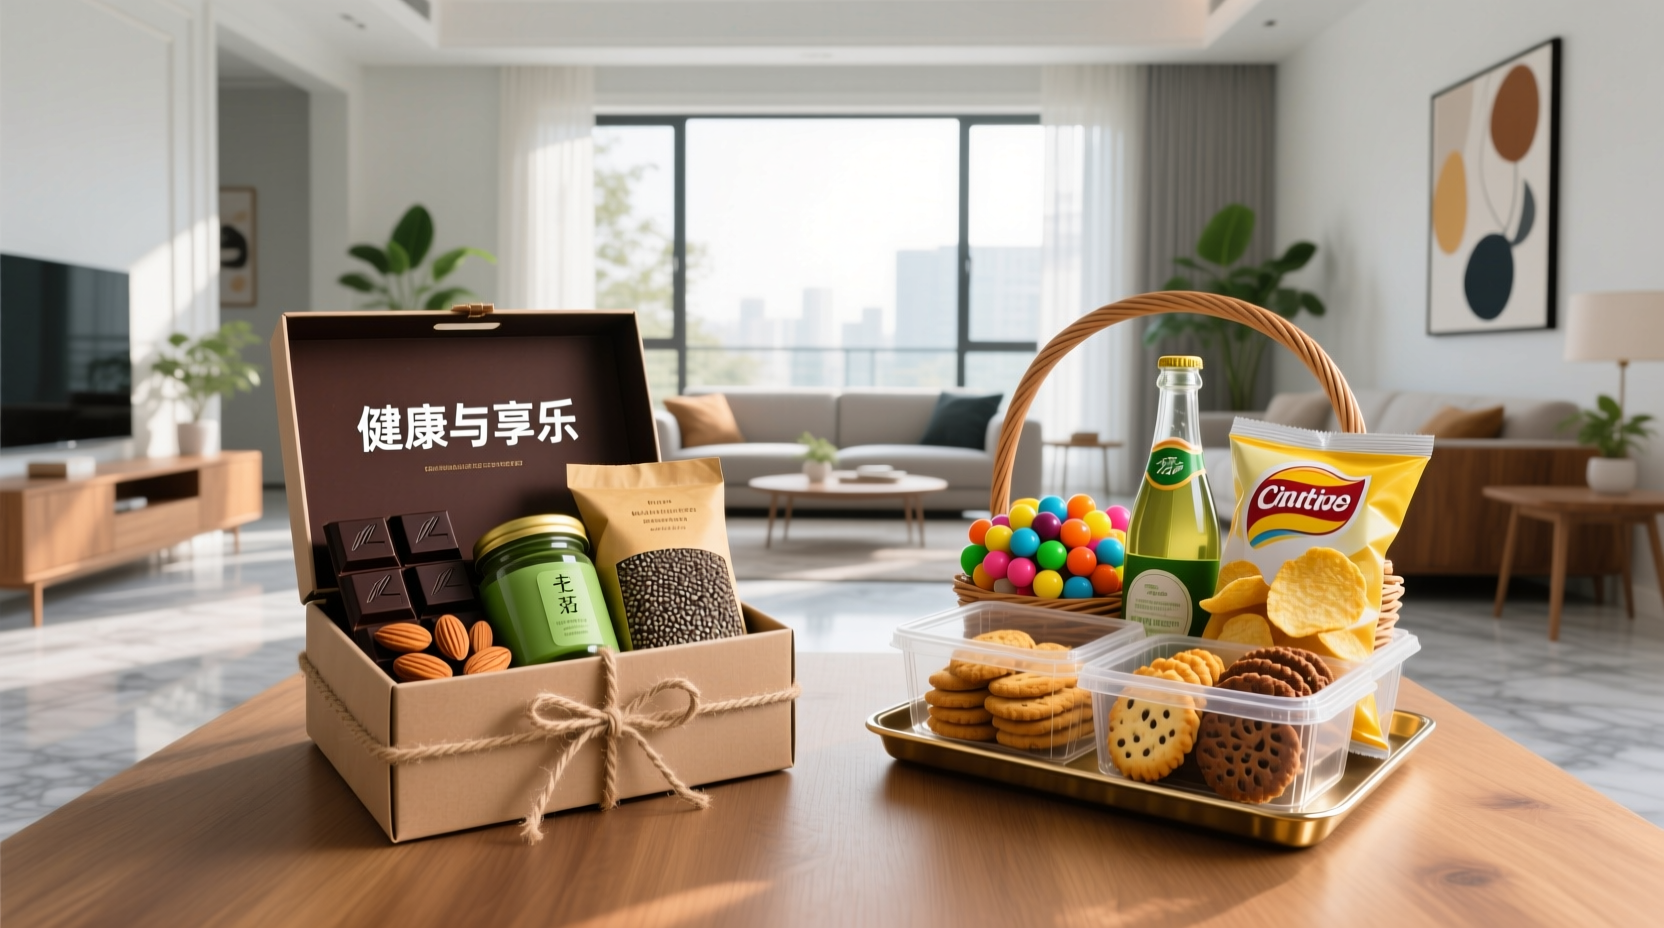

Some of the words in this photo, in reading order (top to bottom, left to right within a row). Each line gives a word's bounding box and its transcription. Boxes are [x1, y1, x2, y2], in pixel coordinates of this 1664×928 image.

[357, 398, 579, 452] 健康与享乐
